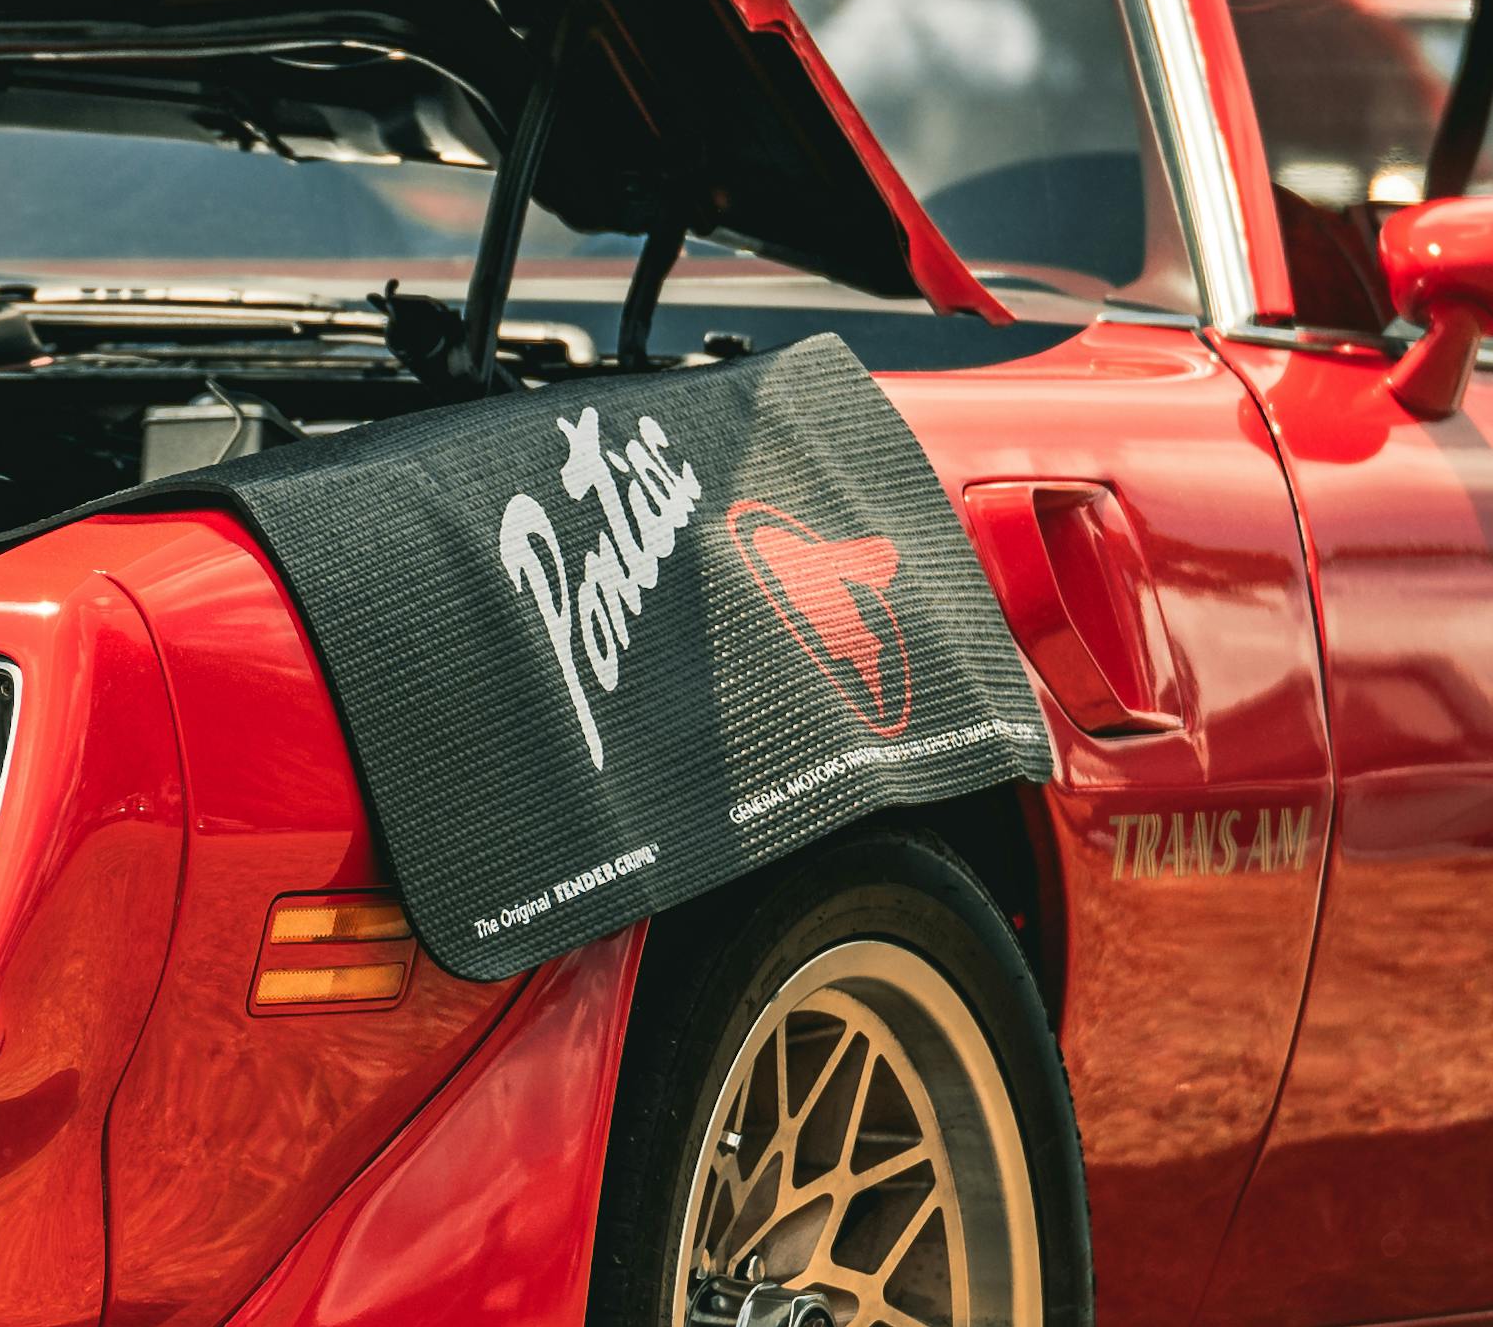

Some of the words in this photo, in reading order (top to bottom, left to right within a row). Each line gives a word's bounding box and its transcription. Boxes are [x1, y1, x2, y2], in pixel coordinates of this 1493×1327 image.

[499, 406, 702, 772] Pontiac
[728, 786, 790, 825] GENERAL
[786, 757, 846, 798] MOTORS
[1108, 809, 1242, 880] TRANS
[1244, 805, 1313, 873] AM
[474, 918, 500, 939] The
[499, 891, 552, 928] Original
[553, 862, 617, 904] FENDER
